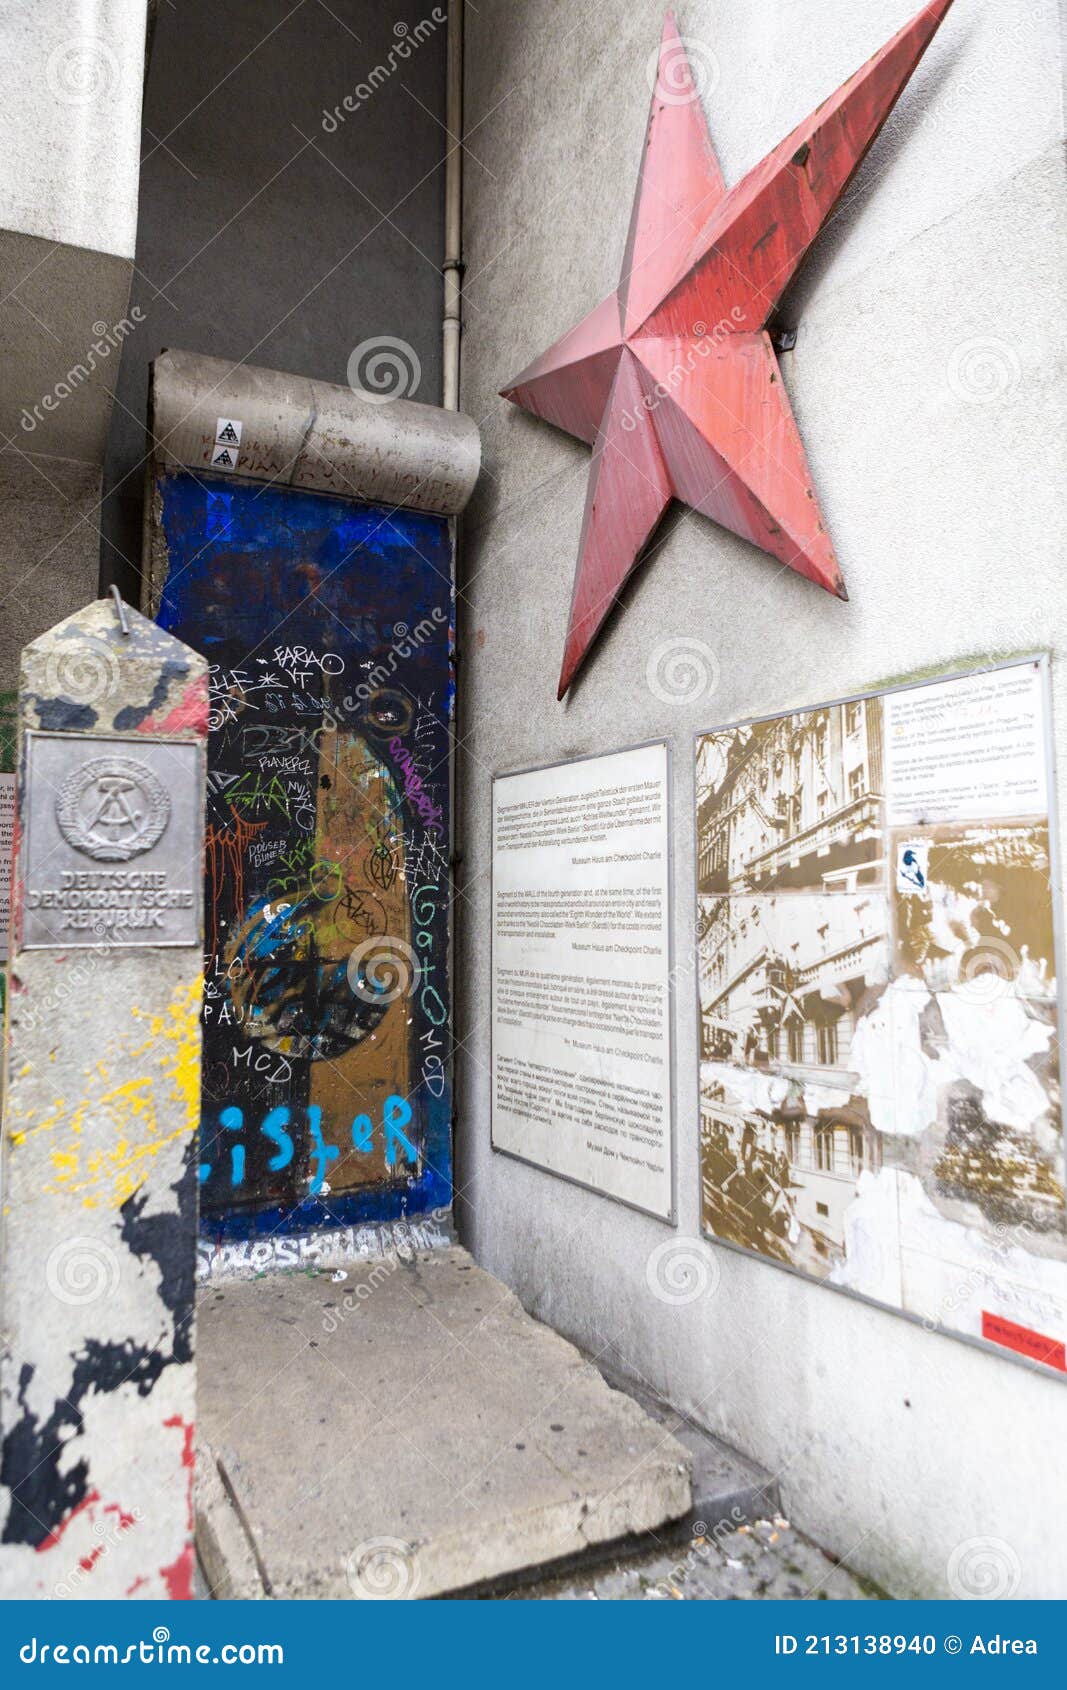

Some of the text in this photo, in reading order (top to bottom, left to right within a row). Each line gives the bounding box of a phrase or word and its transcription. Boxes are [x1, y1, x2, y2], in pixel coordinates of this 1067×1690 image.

[273, 646, 345, 674] FARAO
[614, 852, 642, 863] Checkpoint
[643, 851, 661, 860] Charlie
[60, 870, 168, 890] DEUTSCHE
[28, 889, 194, 909] DEMOKRATISCHE
[614, 944, 642, 955] Checkpoint
[643, 946, 661, 955] Charlie
[233, 1046, 292, 1082] MCD
